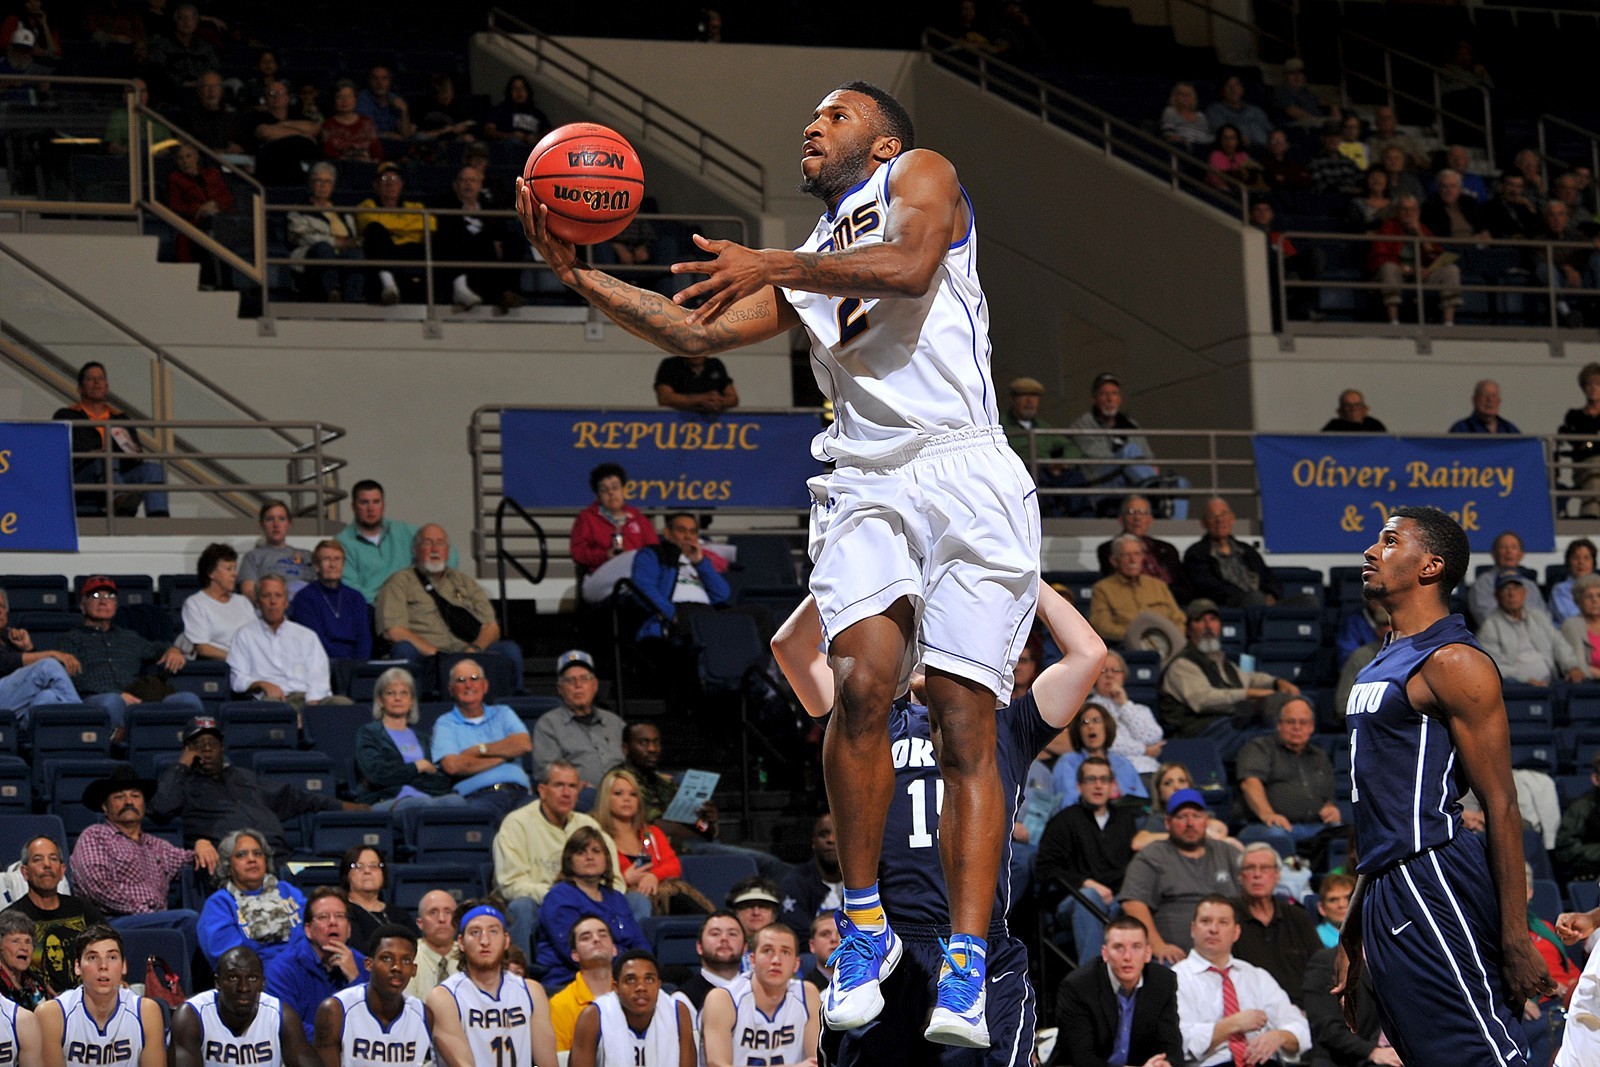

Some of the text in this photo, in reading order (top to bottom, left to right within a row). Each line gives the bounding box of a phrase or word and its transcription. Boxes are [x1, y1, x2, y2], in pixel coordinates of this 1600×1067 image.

[567, 151, 625, 171] NCAA
[553, 184, 631, 211] Wilson
[830, 297, 871, 347] 2
[572, 421, 761, 450] REPUBLIC
[622, 474, 732, 500] ervices
[1292, 456, 1515, 497] Oliver, Rainey
[1340, 504, 1365, 532] &
[891, 736, 936, 768] OK
[907, 779, 945, 848] 1
[469, 1006, 526, 1029] RAMS
[352, 1037, 417, 1063] RAMS
[740, 1024, 795, 1049] RAMS
[67, 1038, 132, 1065] RAMS
[205, 1040, 274, 1065] RAMS
[490, 1035, 517, 1067] 11
